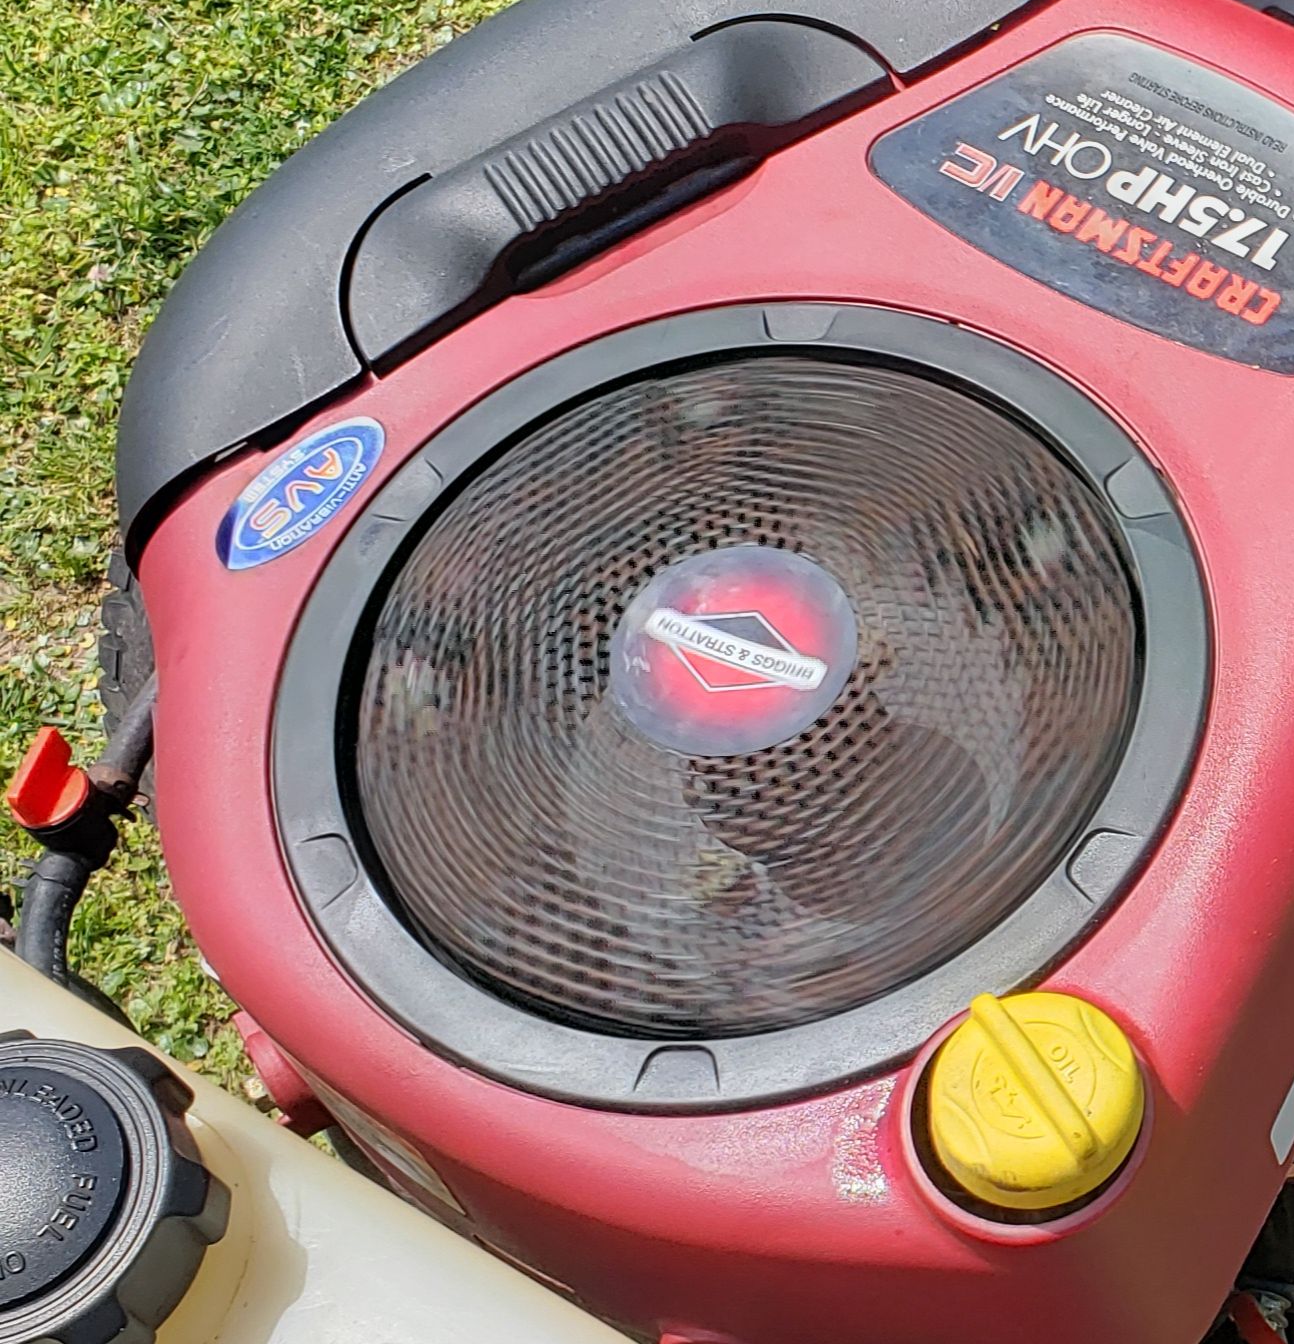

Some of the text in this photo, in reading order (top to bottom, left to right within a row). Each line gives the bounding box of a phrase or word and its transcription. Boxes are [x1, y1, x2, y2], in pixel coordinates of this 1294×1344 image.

[1075, 92, 1102, 113] Life
[1099, 88, 1264, 174] Dual Element Air Cleaner
[1101, 103, 1151, 136] Longer
[1126, 70, 1288, 153] READ INSTRUCTIONS BEFORE STARTING
[994, 103, 1113, 186] OHV
[1043, 93, 1290, 219] Durable Overhead Valve Performance
[1161, 134, 1207, 163] Sleeve
[1208, 155, 1238, 178] Iron
[1238, 170, 1271, 194] Cast
[937, 140, 1286, 326] CRAFTSMAN I/C
[244, 448, 306, 504] SYSTEM
[250, 446, 344, 540] AVS
[268, 461, 367, 552] ANTI-VIBRATION
[656, 616, 815, 679] BRIGGS & STRATTON
[1050, 1045, 1081, 1084] OIL
[0, 1079, 98, 1242] NLEADED FUEL
